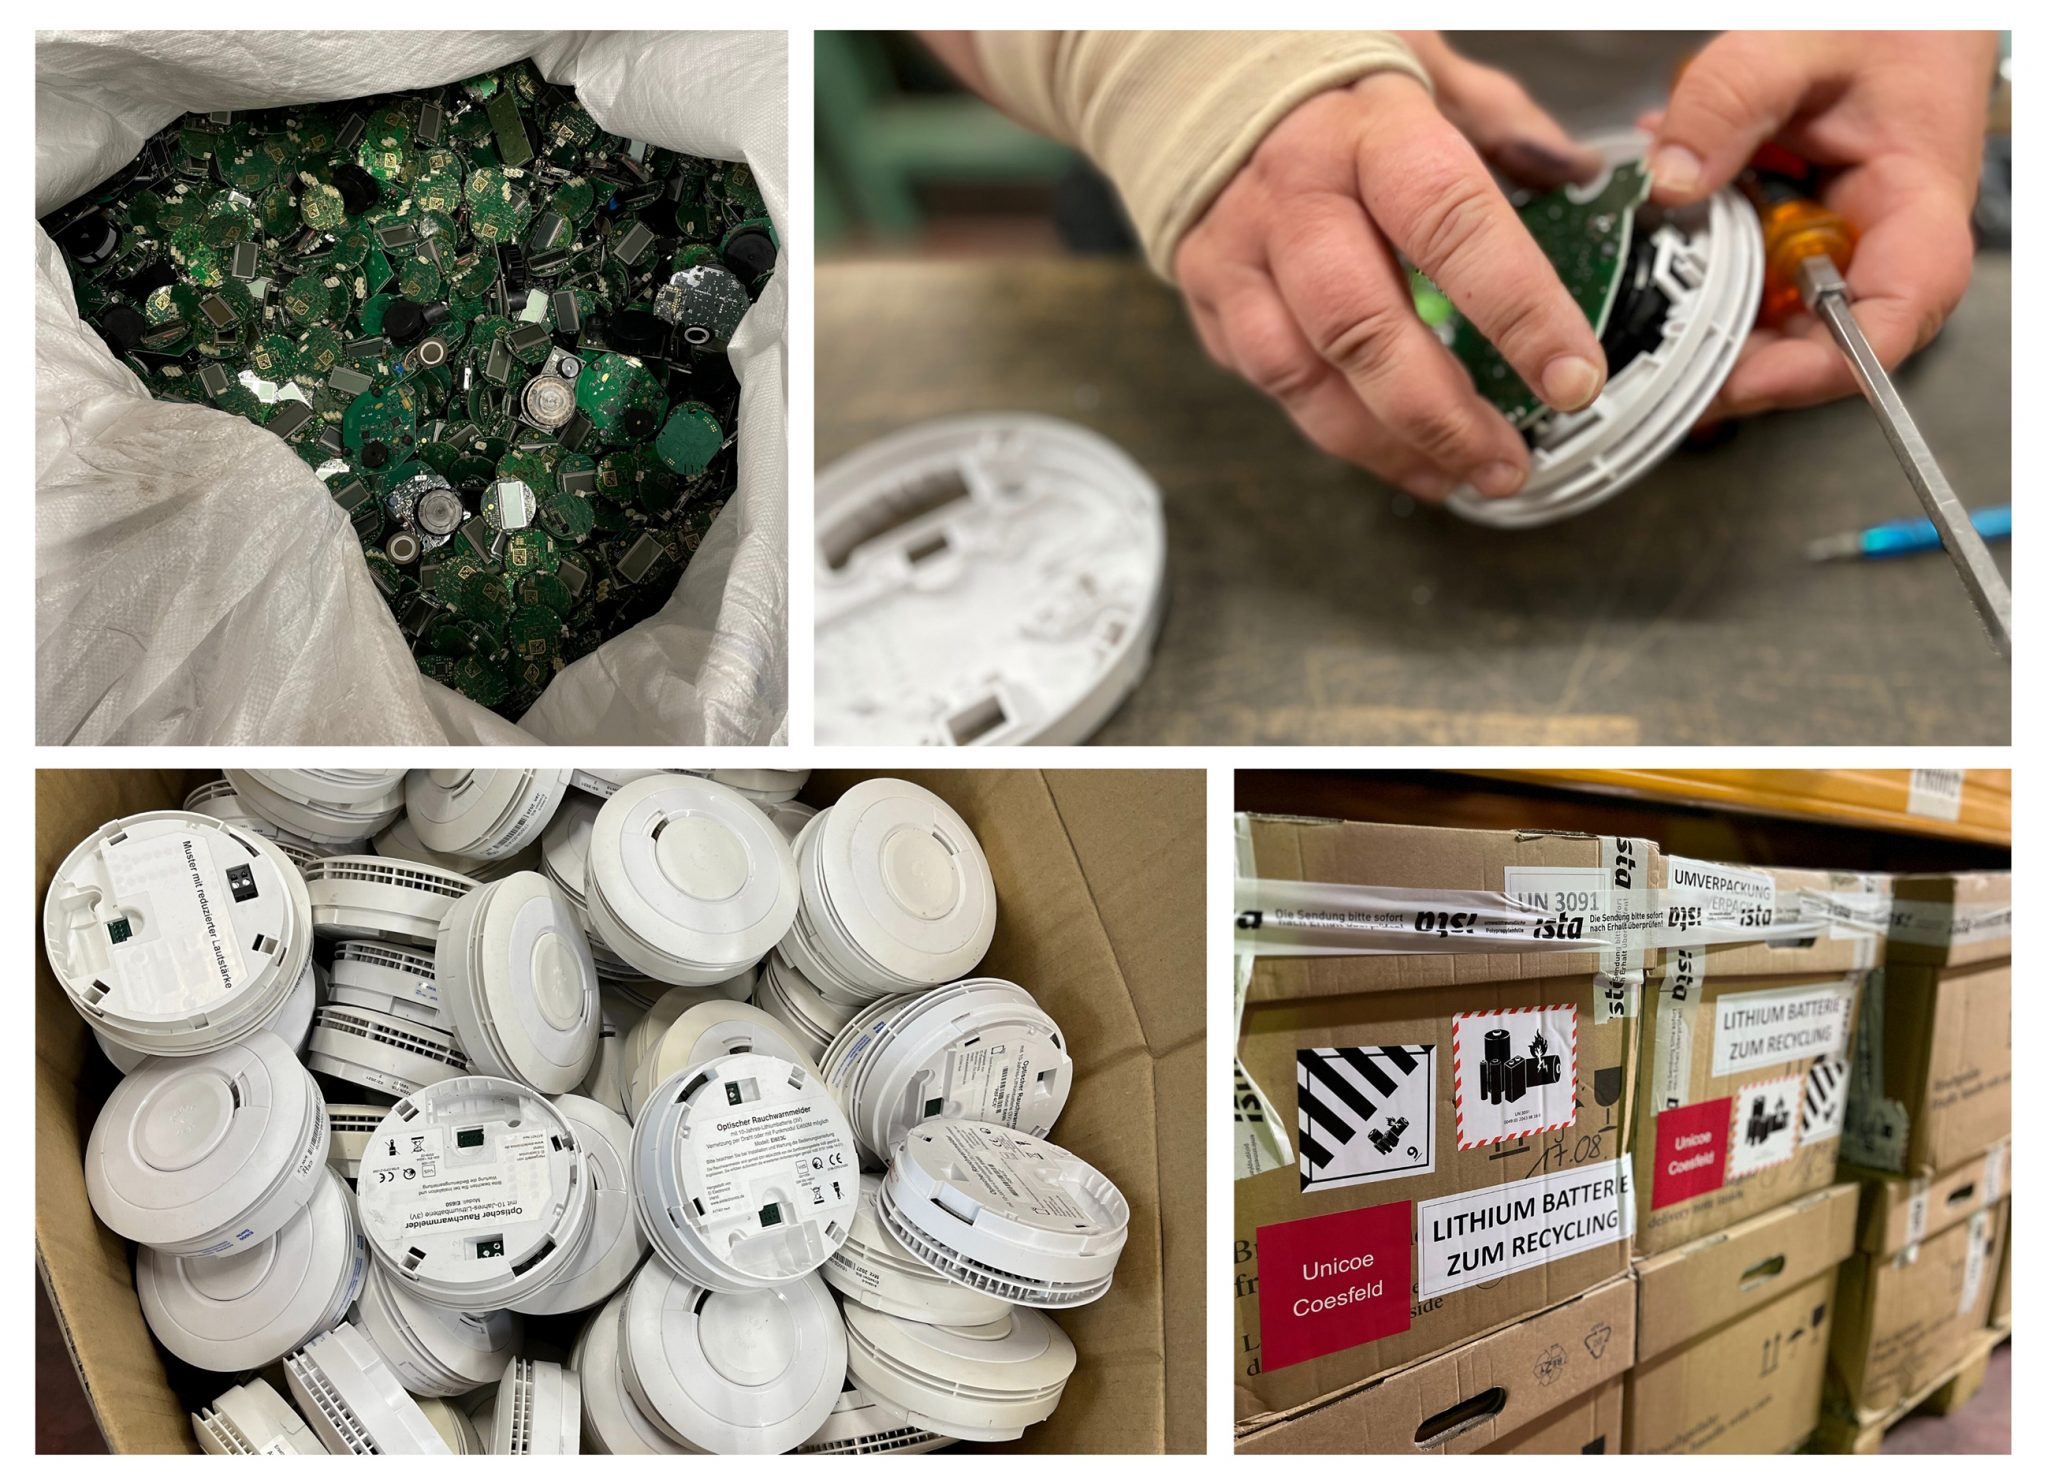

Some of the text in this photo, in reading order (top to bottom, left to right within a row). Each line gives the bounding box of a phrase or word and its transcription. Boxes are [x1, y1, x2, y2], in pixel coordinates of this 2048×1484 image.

[1674, 869, 1771, 901] UMVERPACKUNG
[181, 839, 234, 989] Muster mit reduzierter Lautstärke
[1555, 891, 1599, 912] 3091
[1275, 909, 1293, 919] Die
[1297, 910, 1345, 923] Sendung
[1348, 911, 1371, 922] bitte
[1374, 912, 1403, 922] sofort
[1533, 911, 1583, 939] ista
[1590, 911, 1663, 923] Die Sendung bitte sofort
[1590, 920, 1664, 933] nach Erhalt überprüfen!
[1740, 904, 1772, 927] ista
[1671, 950, 1693, 1001] ista
[1723, 1006, 1785, 1031] LITHIUM
[1787, 996, 1841, 1021] BATTERIE
[1729, 1025, 1833, 1060] ZUM RECYCLING
[1018, 1060, 1029, 1091] Optischer
[716, 1104, 811, 1132] Optischer Rauchwarnmelder
[706, 1139, 731, 1150] Vernetzung
[740, 1134, 753, 1142] Draht
[772, 1125, 795, 1135] Funkmodul
[1674, 1130, 1712, 1151] Unicoe
[1667, 1151, 1715, 1176] Coesfeld
[404, 1206, 522, 1229] Optischer Rauchwarnmelder
[409, 1211, 423, 1219] (3V)
[424, 1201, 505, 1217] 10-Jahres-Lithiumbatterie
[1433, 1175, 1629, 1242] LITHIUM BATTERIE
[1447, 1209, 1618, 1277] ZUM RECYCLING
[855, 1266, 868, 1274] 2027
[1302, 1253, 1375, 1281] Unicoe
[1292, 1280, 1383, 1317] Coesfeld
